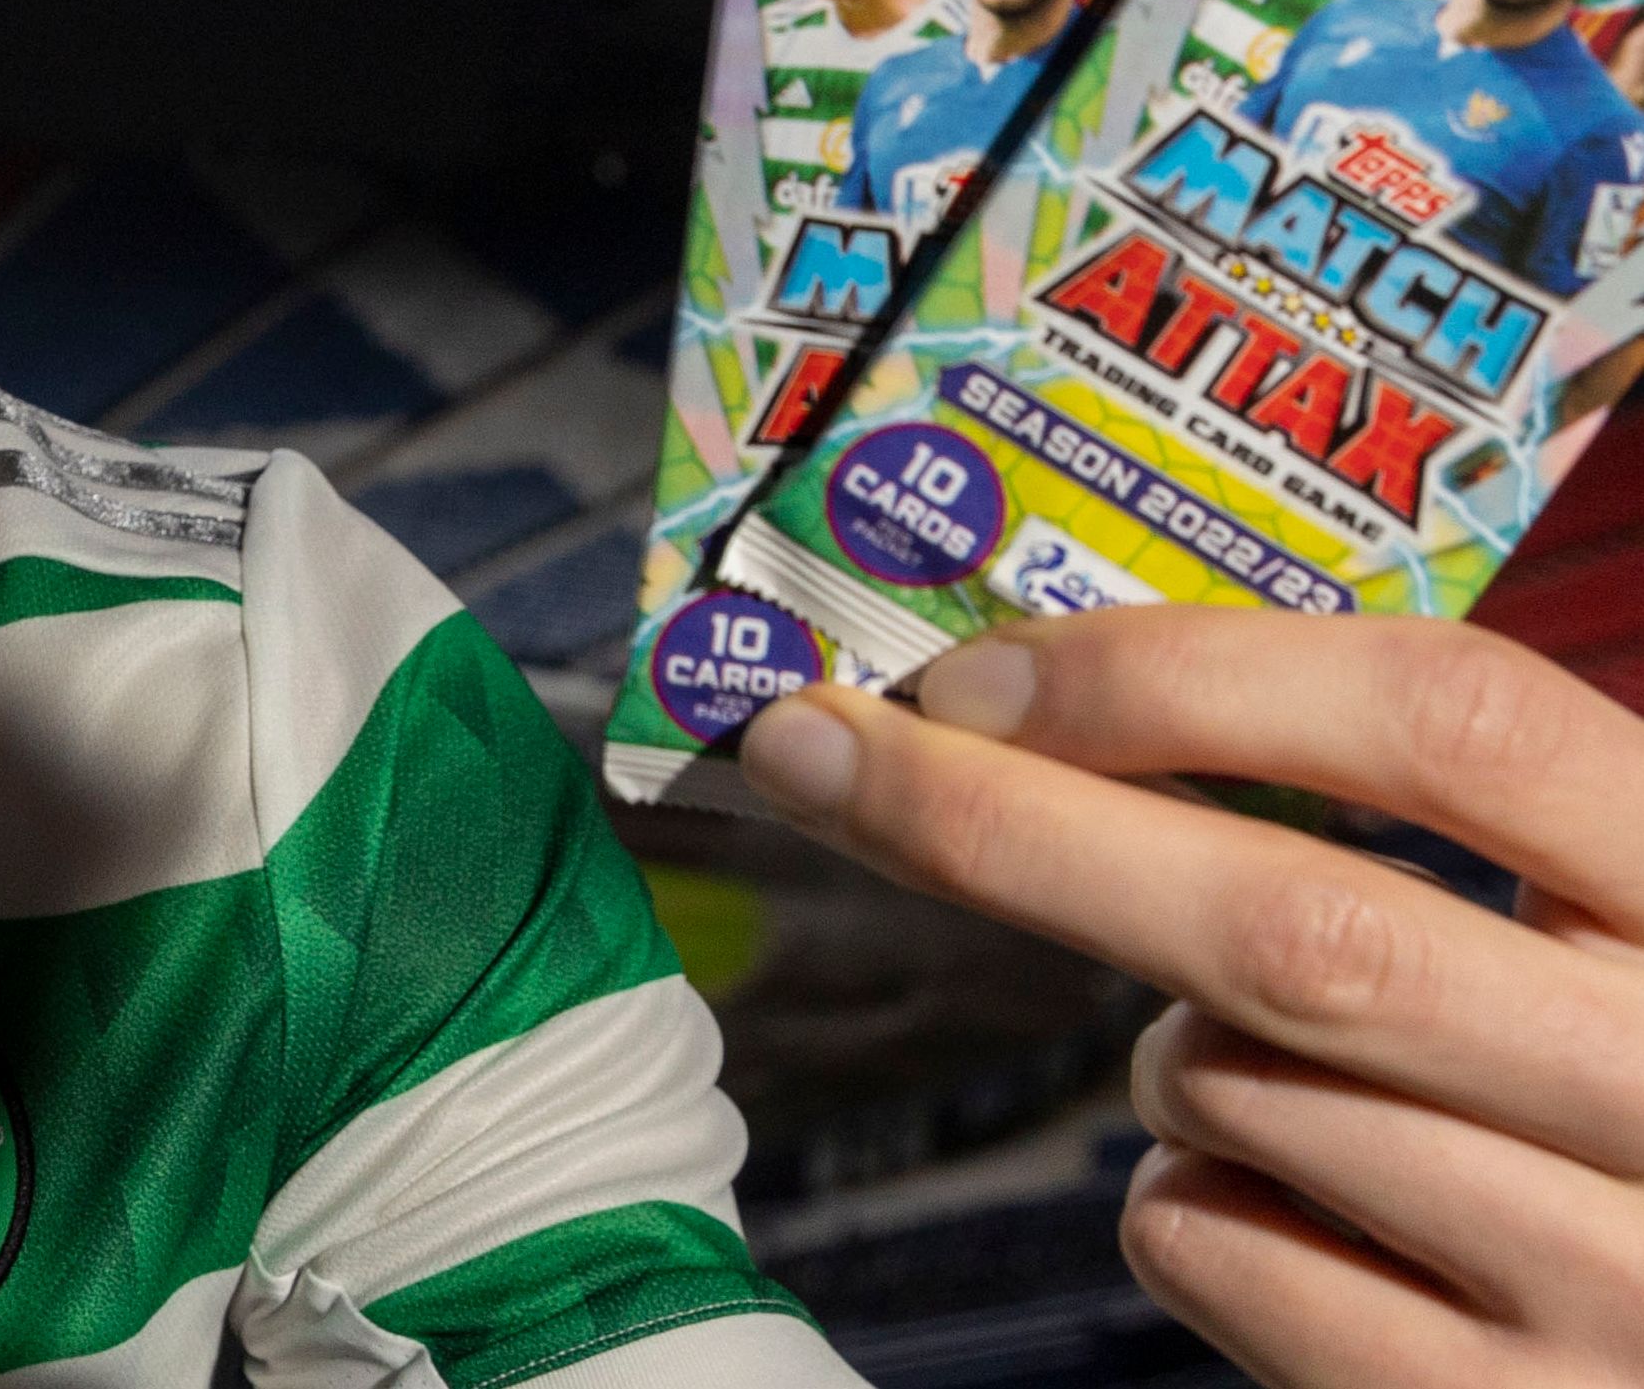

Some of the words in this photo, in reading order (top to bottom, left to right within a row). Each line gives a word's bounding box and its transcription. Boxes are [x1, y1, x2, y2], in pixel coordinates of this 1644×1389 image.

[1127, 113, 1545, 398] MATCH
[1041, 325, 1179, 418] TRADING
[1185, 413, 1274, 476] CARD
[1282, 464, 1387, 544] GAME
[1044, 231, 1458, 526] ATTAX
[843, 463, 977, 561] CARDS
[901, 441, 969, 507] 10
[959, 371, 1142, 501] SEASON
[1136, 481, 1341, 613] 2022/23
[666, 655, 805, 698] CARDS
[711, 612, 771, 661] 10
